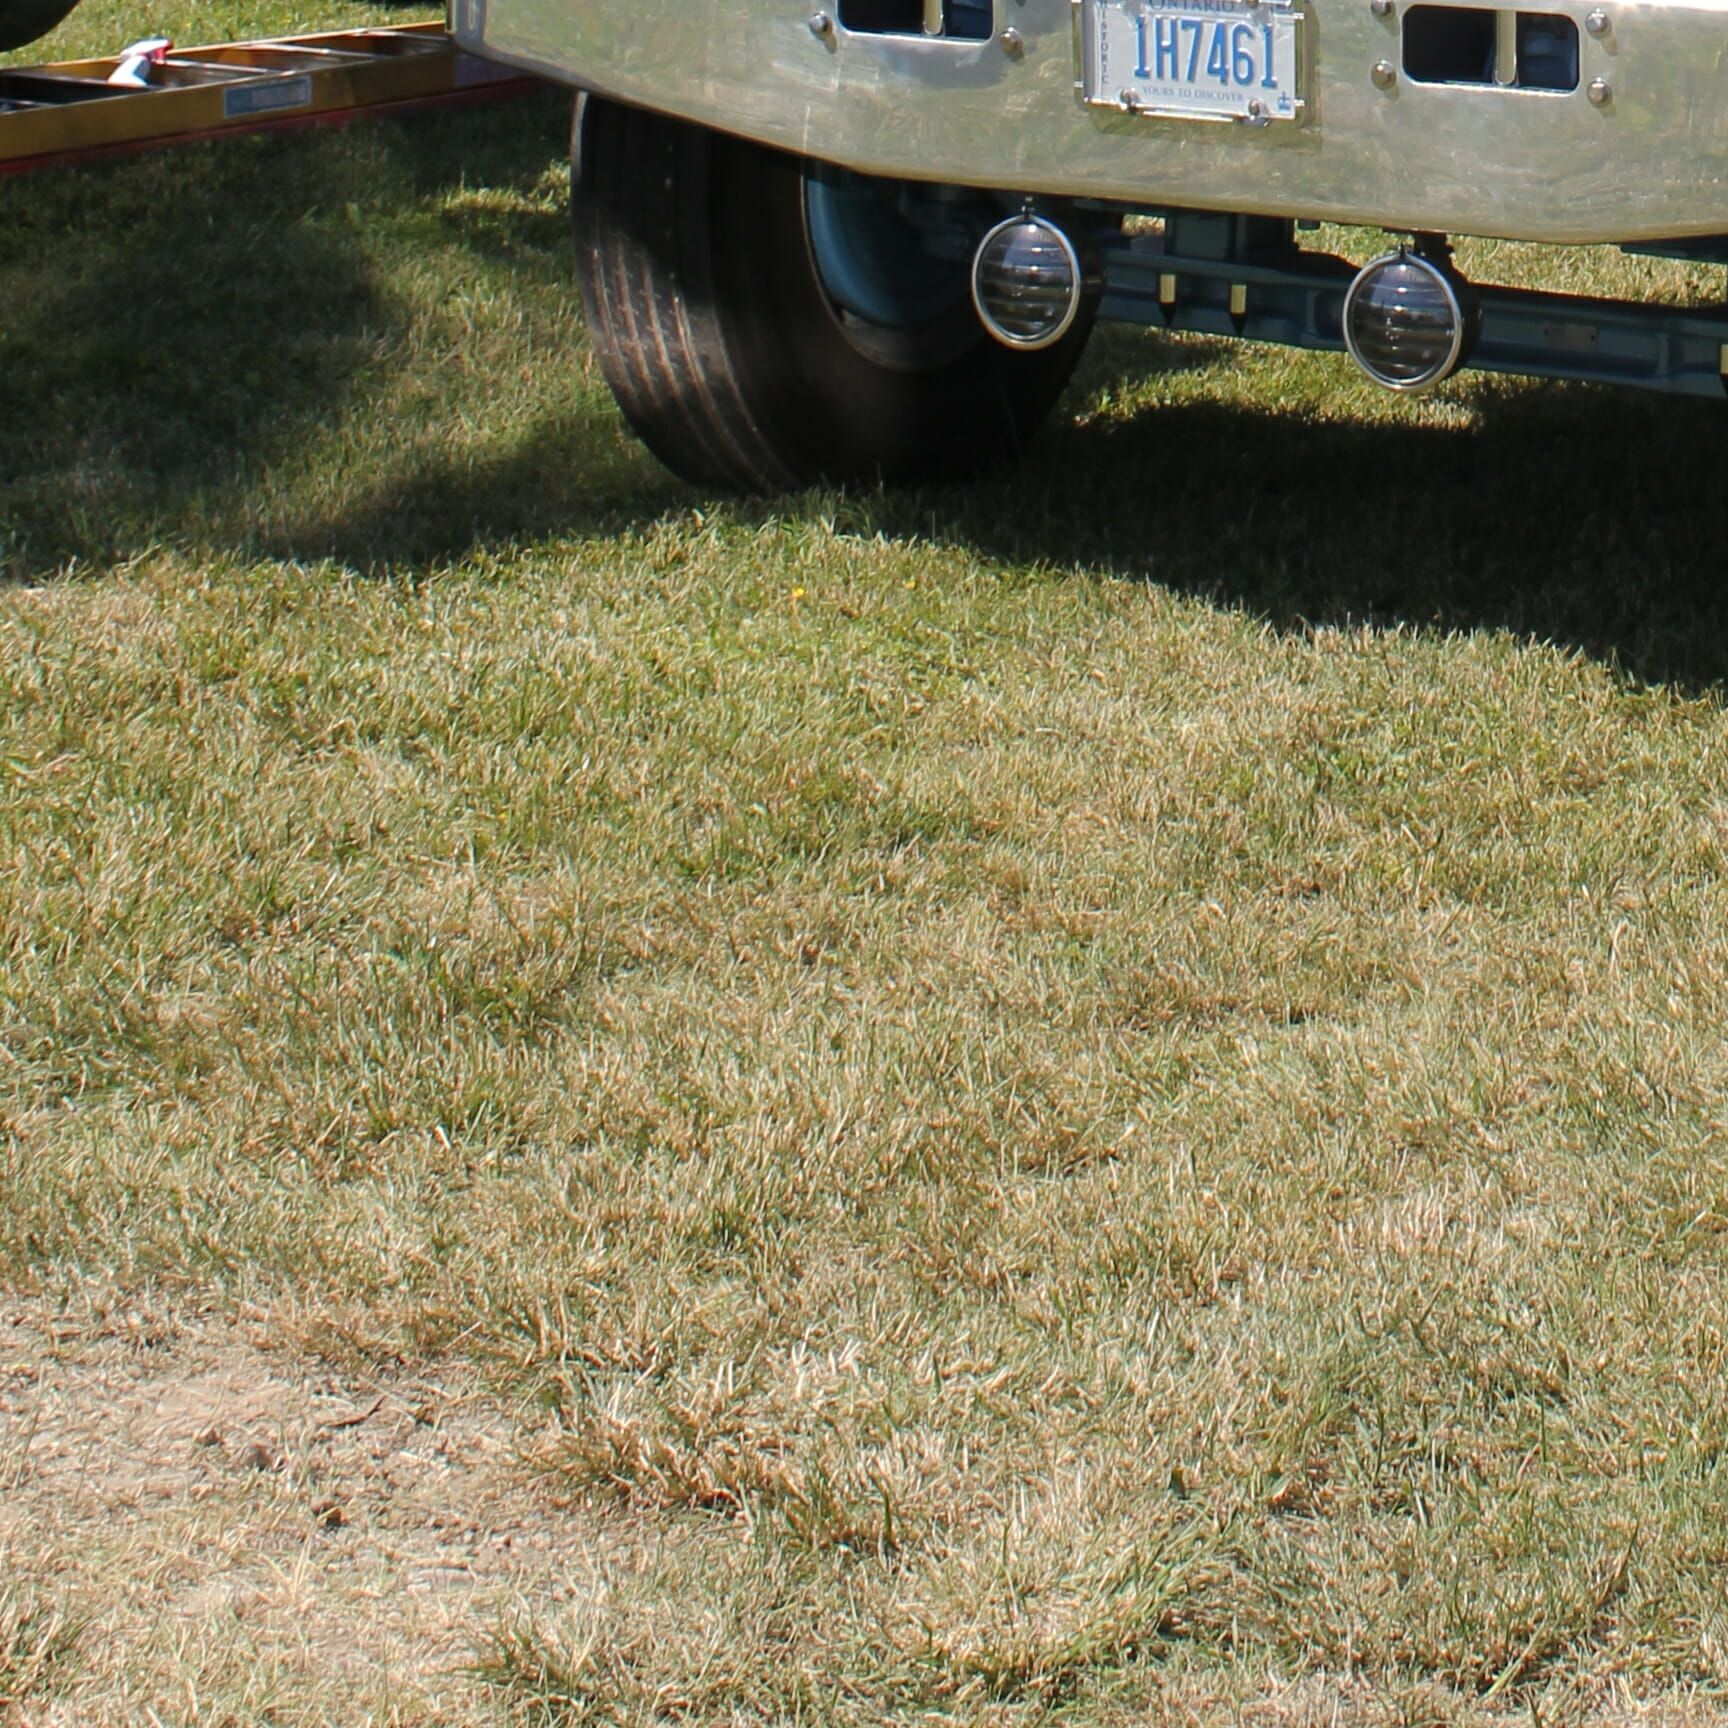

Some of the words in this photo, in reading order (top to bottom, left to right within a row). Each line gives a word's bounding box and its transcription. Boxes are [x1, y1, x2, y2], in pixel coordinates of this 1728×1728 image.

[1134, 14, 1278, 89] 1H7461
[1141, 86, 1175, 96] YOURS
[1178, 87, 1192, 98] TO
[1194, 88, 1244, 102] DISCOVER
